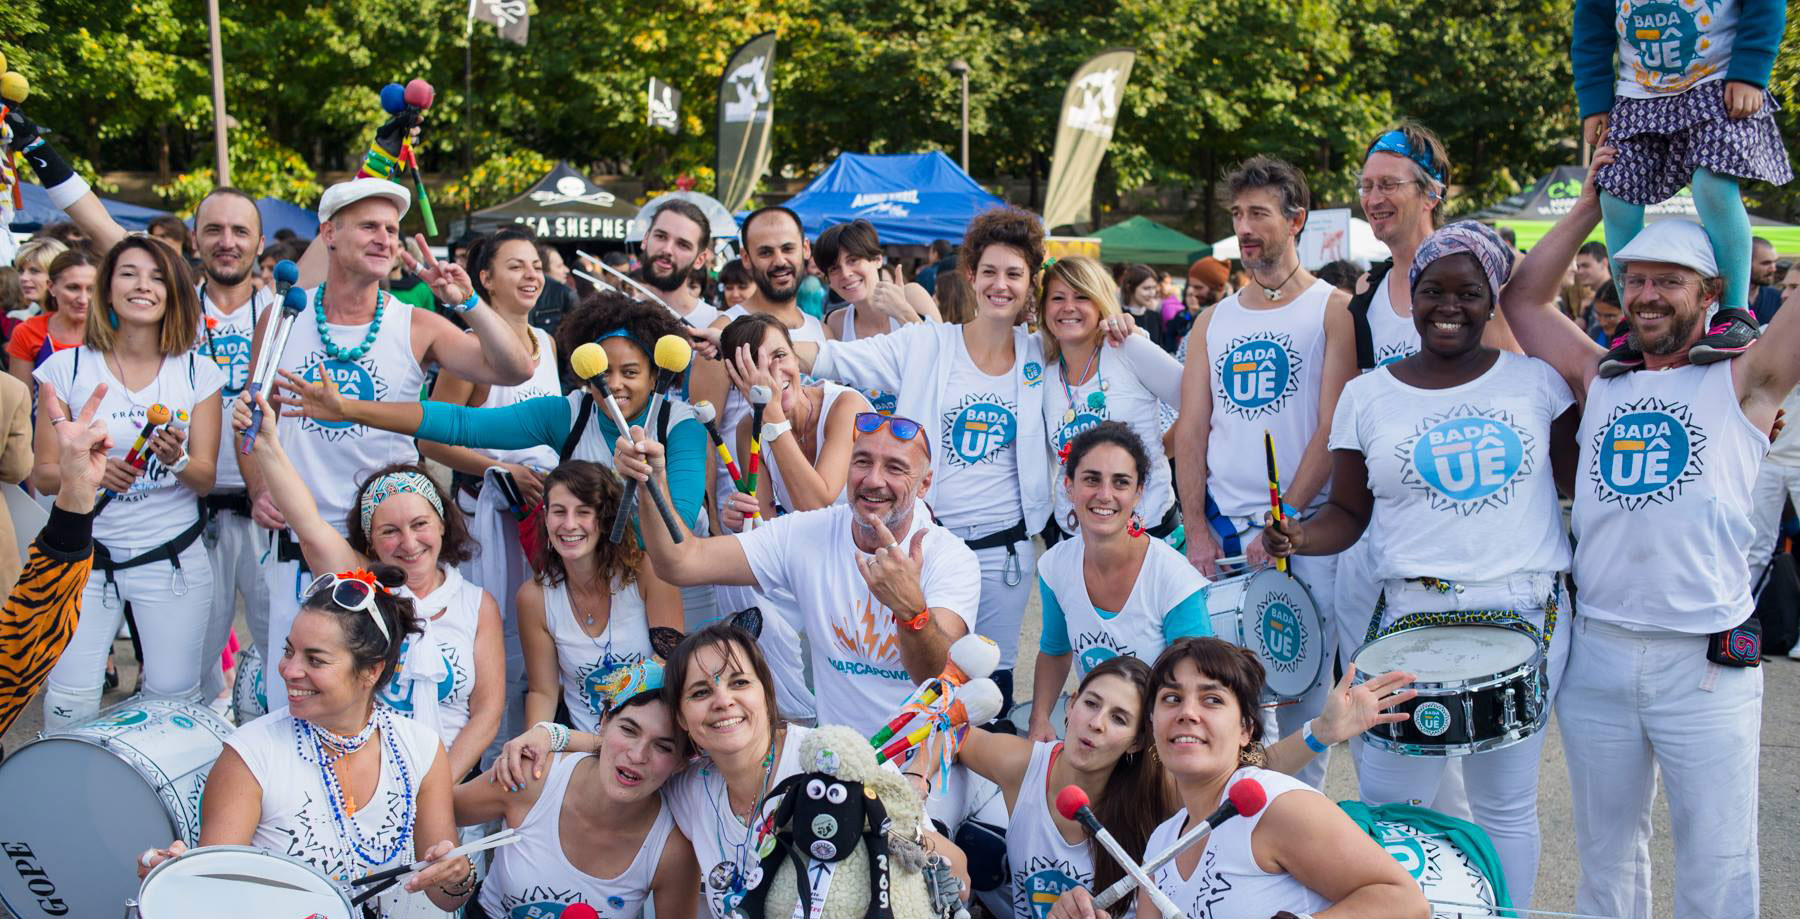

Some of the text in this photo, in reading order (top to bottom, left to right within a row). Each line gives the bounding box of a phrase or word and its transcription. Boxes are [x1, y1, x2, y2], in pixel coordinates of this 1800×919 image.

[1633, 11, 1681, 28] BADA
[1233, 347, 1277, 363] BADA
[966, 408, 1008, 426] BADA
[1428, 423, 1502, 445] BADA
[1613, 421, 1672, 439] BADA
[1271, 607, 1295, 627] BADA
[0, 842, 69, 917] GOPE
[876, 854, 890, 909] 269
